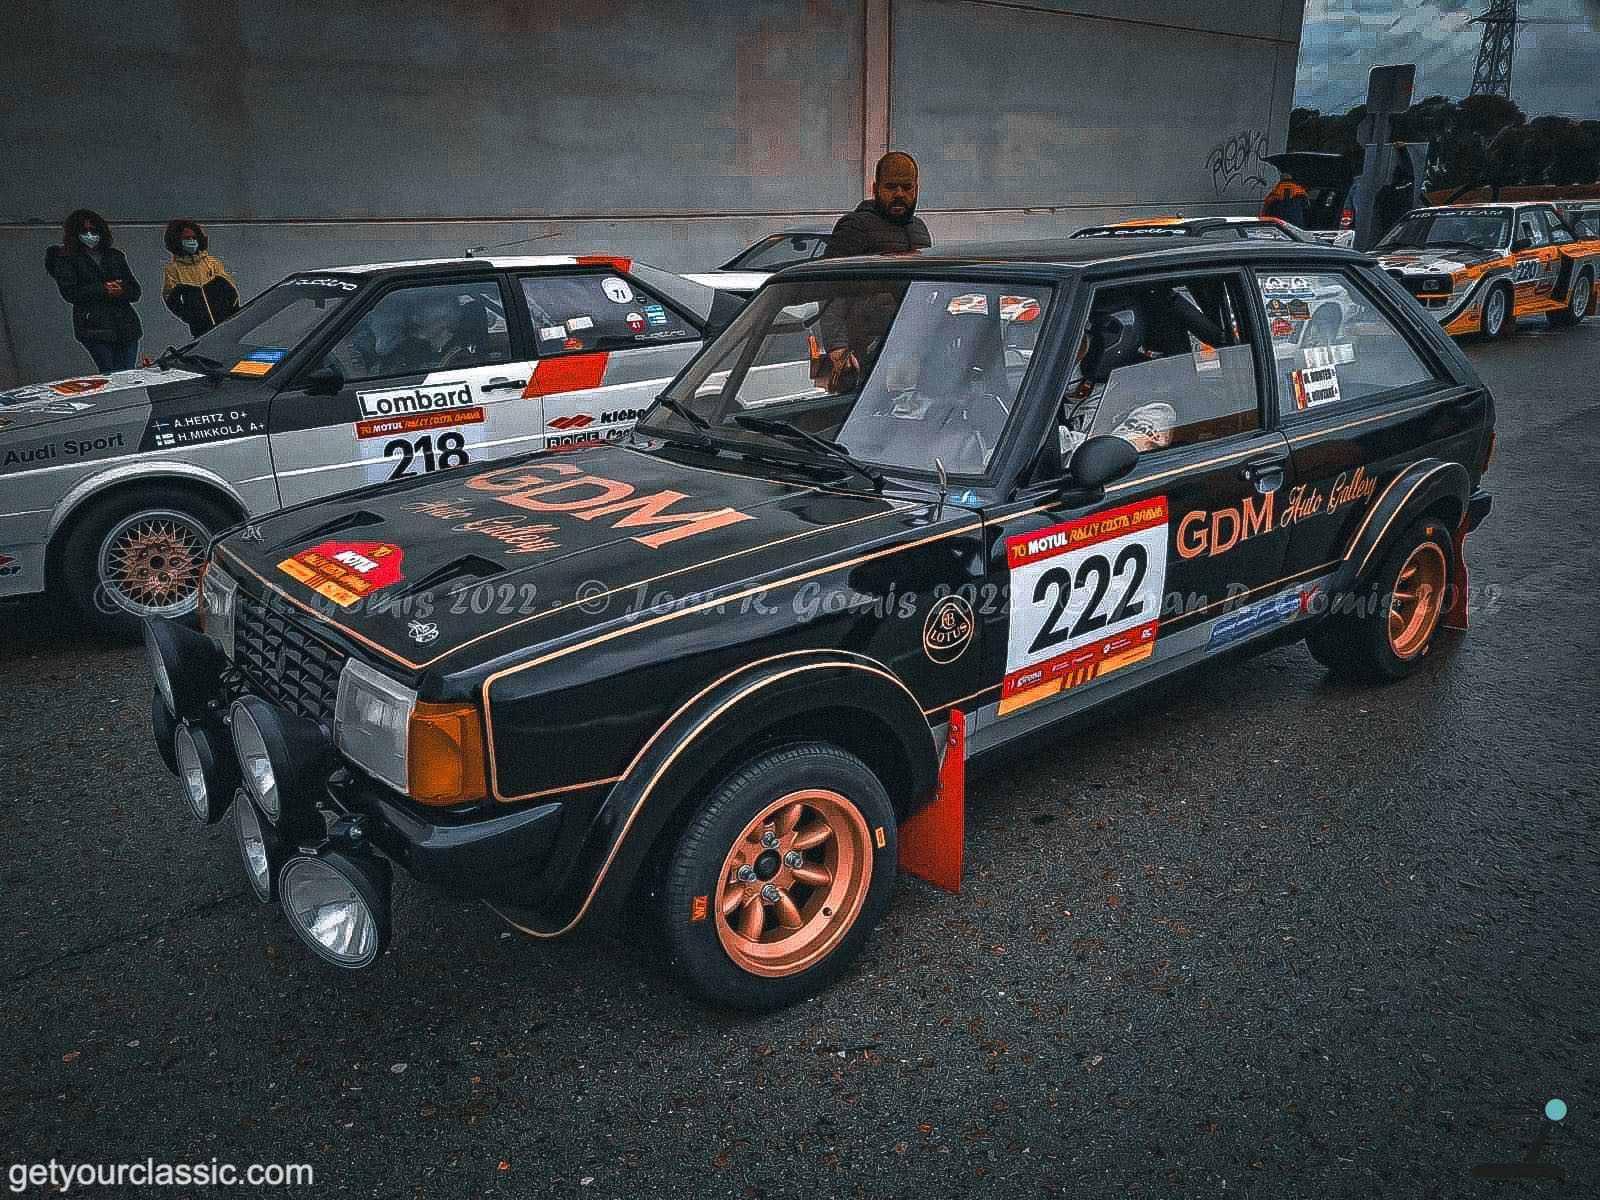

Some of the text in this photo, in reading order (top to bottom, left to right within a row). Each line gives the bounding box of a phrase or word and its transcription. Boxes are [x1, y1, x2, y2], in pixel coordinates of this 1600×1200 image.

[358, 384, 474, 417] Lombard
[174, 413, 225, 428] A.HERTZ
[177, 424, 245, 441] H.MIKKOLA
[373, 421, 404, 433] MOTUL
[4, 432, 124, 465] Audi Sport
[383, 432, 470, 481] 218
[464, 463, 757, 549] GDM
[1176, 465, 1378, 560] GDM Auto Gallery
[1028, 530, 1068, 555] MOTUL
[1069, 520, 1101, 543] RALLY
[1100, 515, 1130, 533] COSTA
[1131, 506, 1163, 525] BRAVA
[1028, 543, 1149, 654] 222
[930, 621, 968, 643] LOTUS
